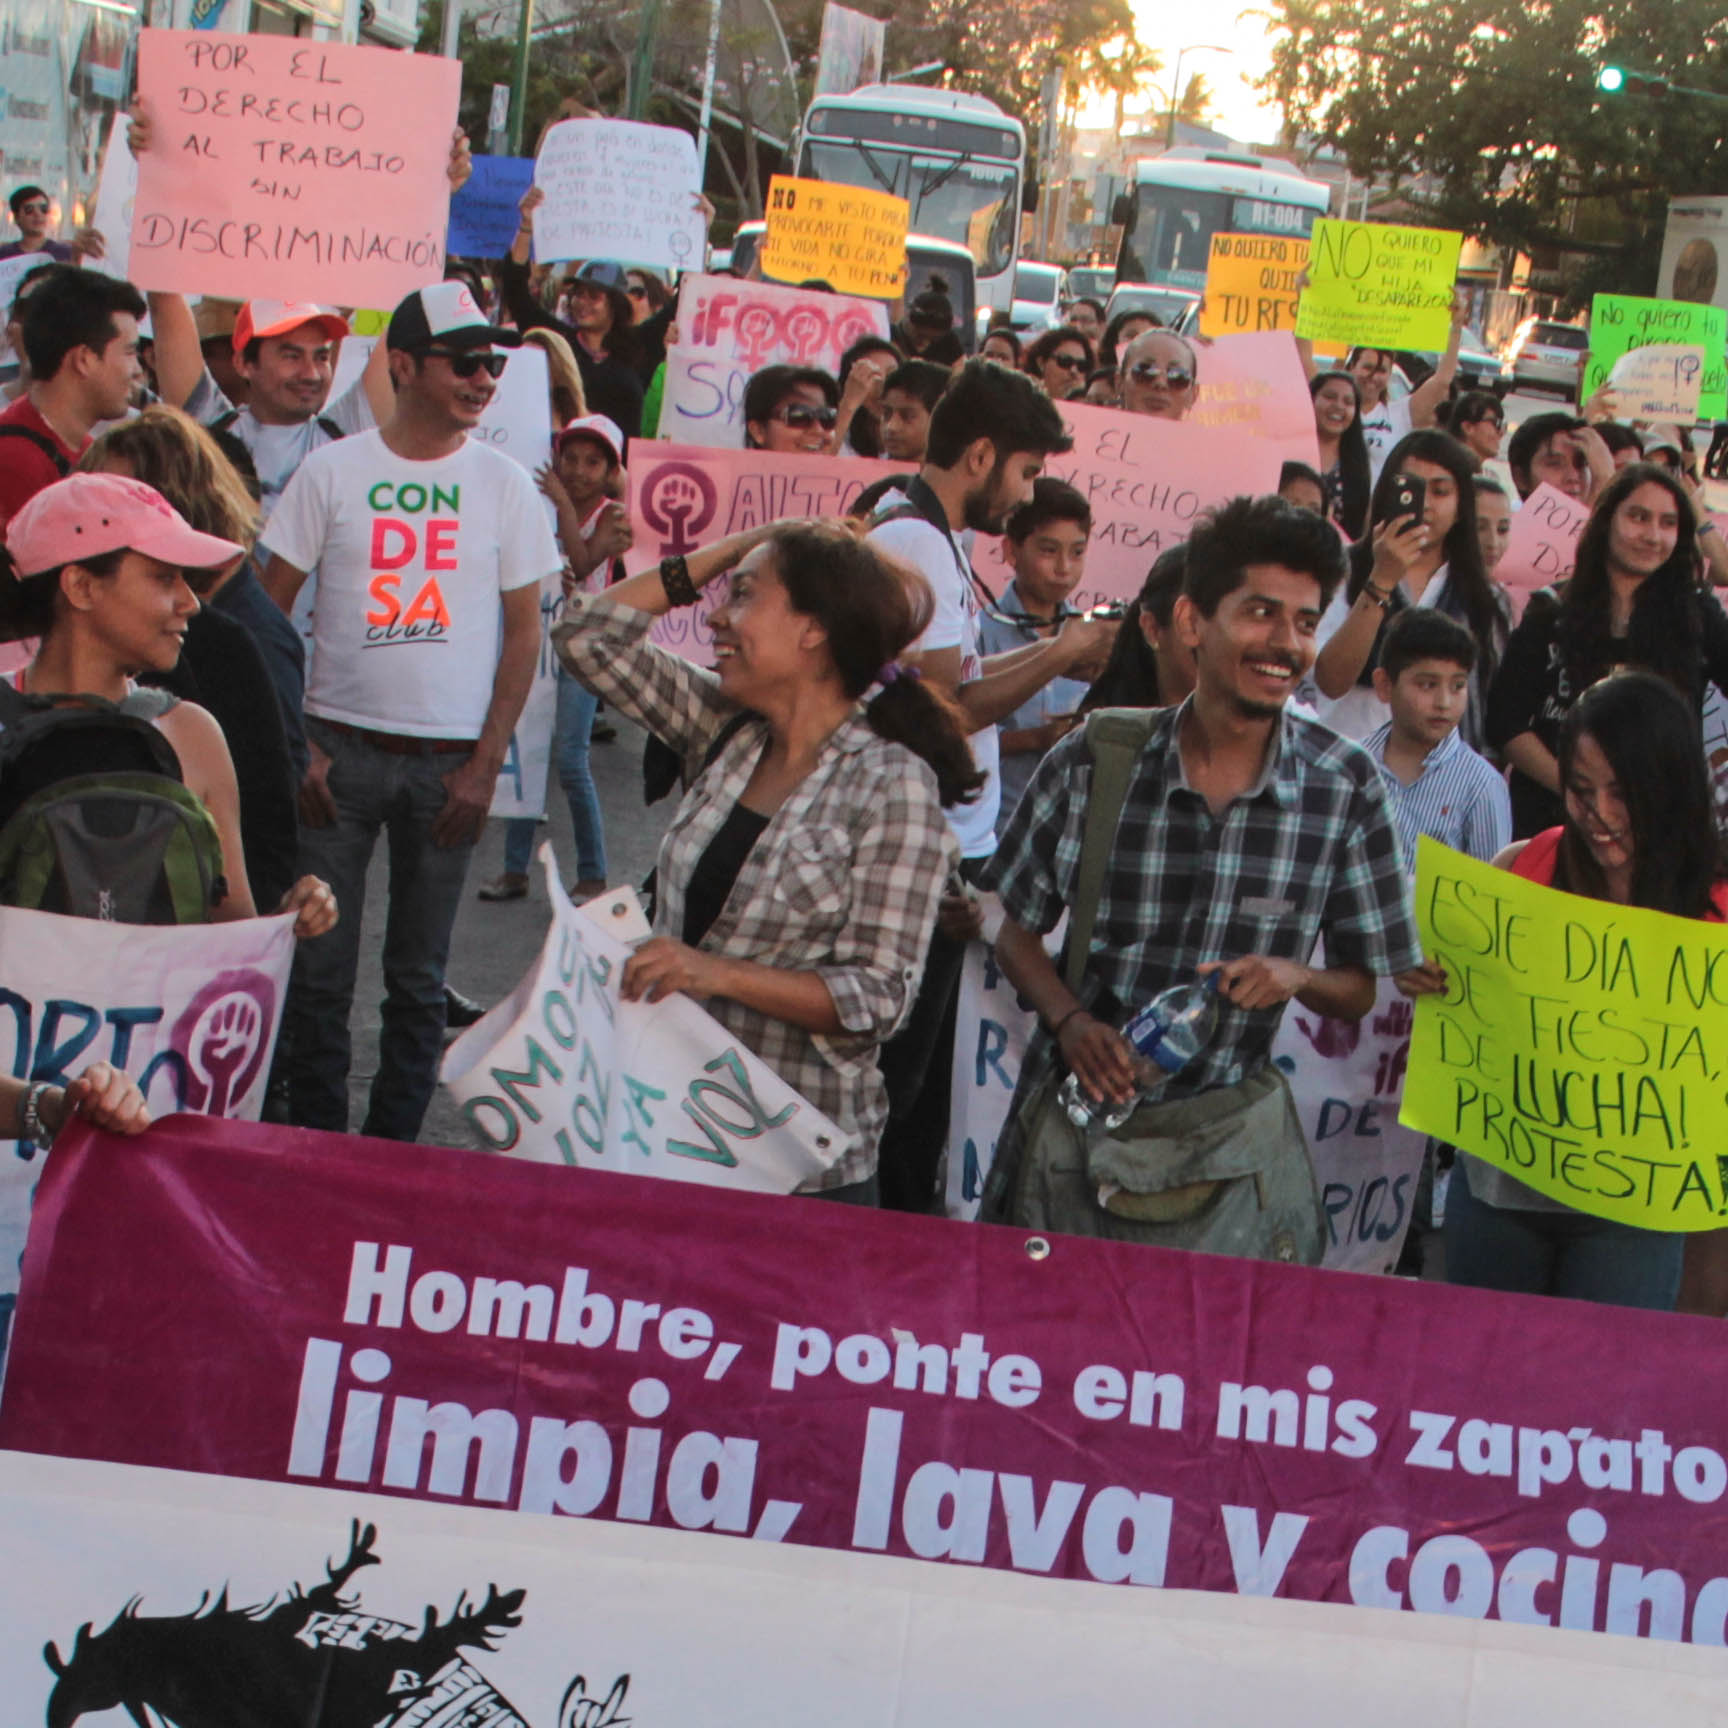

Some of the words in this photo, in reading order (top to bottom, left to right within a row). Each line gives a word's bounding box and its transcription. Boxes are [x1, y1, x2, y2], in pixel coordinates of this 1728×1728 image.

[185, 40, 255, 74] POR
[290, 49, 344, 85] EL
[179, 86, 366, 132] DERECHO
[183, 133, 219, 160] AL
[253, 139, 405, 175] TRABAJO
[250, 179, 302, 201] SIN
[773, 186, 797, 210] NO
[136, 213, 446, 270] DISCRIMINACIÓN
[1212, 236, 1233, 257] NO
[1234, 240, 1288, 264] QUIERO
[1313, 222, 1373, 281] NO
[1382, 230, 1443, 256] QUIERO
[1259, 266, 1299, 294] QUIE
[1376, 254, 1407, 271] QUE
[1412, 257, 1433, 274] MI
[1218, 293, 1251, 328] TU
[1600, 302, 1624, 326] No
[1636, 304, 1692, 334] quiero
[1095, 429, 1139, 467] EL
[367, 481, 460, 515] CON
[369, 517, 460, 571] DE
[366, 573, 451, 628] SA
[363, 606, 448, 641] club
[1430, 875, 1533, 974] ESTE
[1564, 921, 1640, 999] DÍA
[1434, 949, 1496, 1029] DE
[1435, 1012, 1502, 1083] DE
[1512, 1053, 1692, 1152] LUCHA!
[343, 1241, 742, 1381] Hombre,
[770, 1322, 1042, 1408] ponte
[1073, 1364, 1186, 1432] en
[1215, 1364, 1378, 1459] mis
[286, 1337, 804, 1543] limpia,
[852, 1406, 1174, 1590] lava
[1219, 1504, 1311, 1598] y
